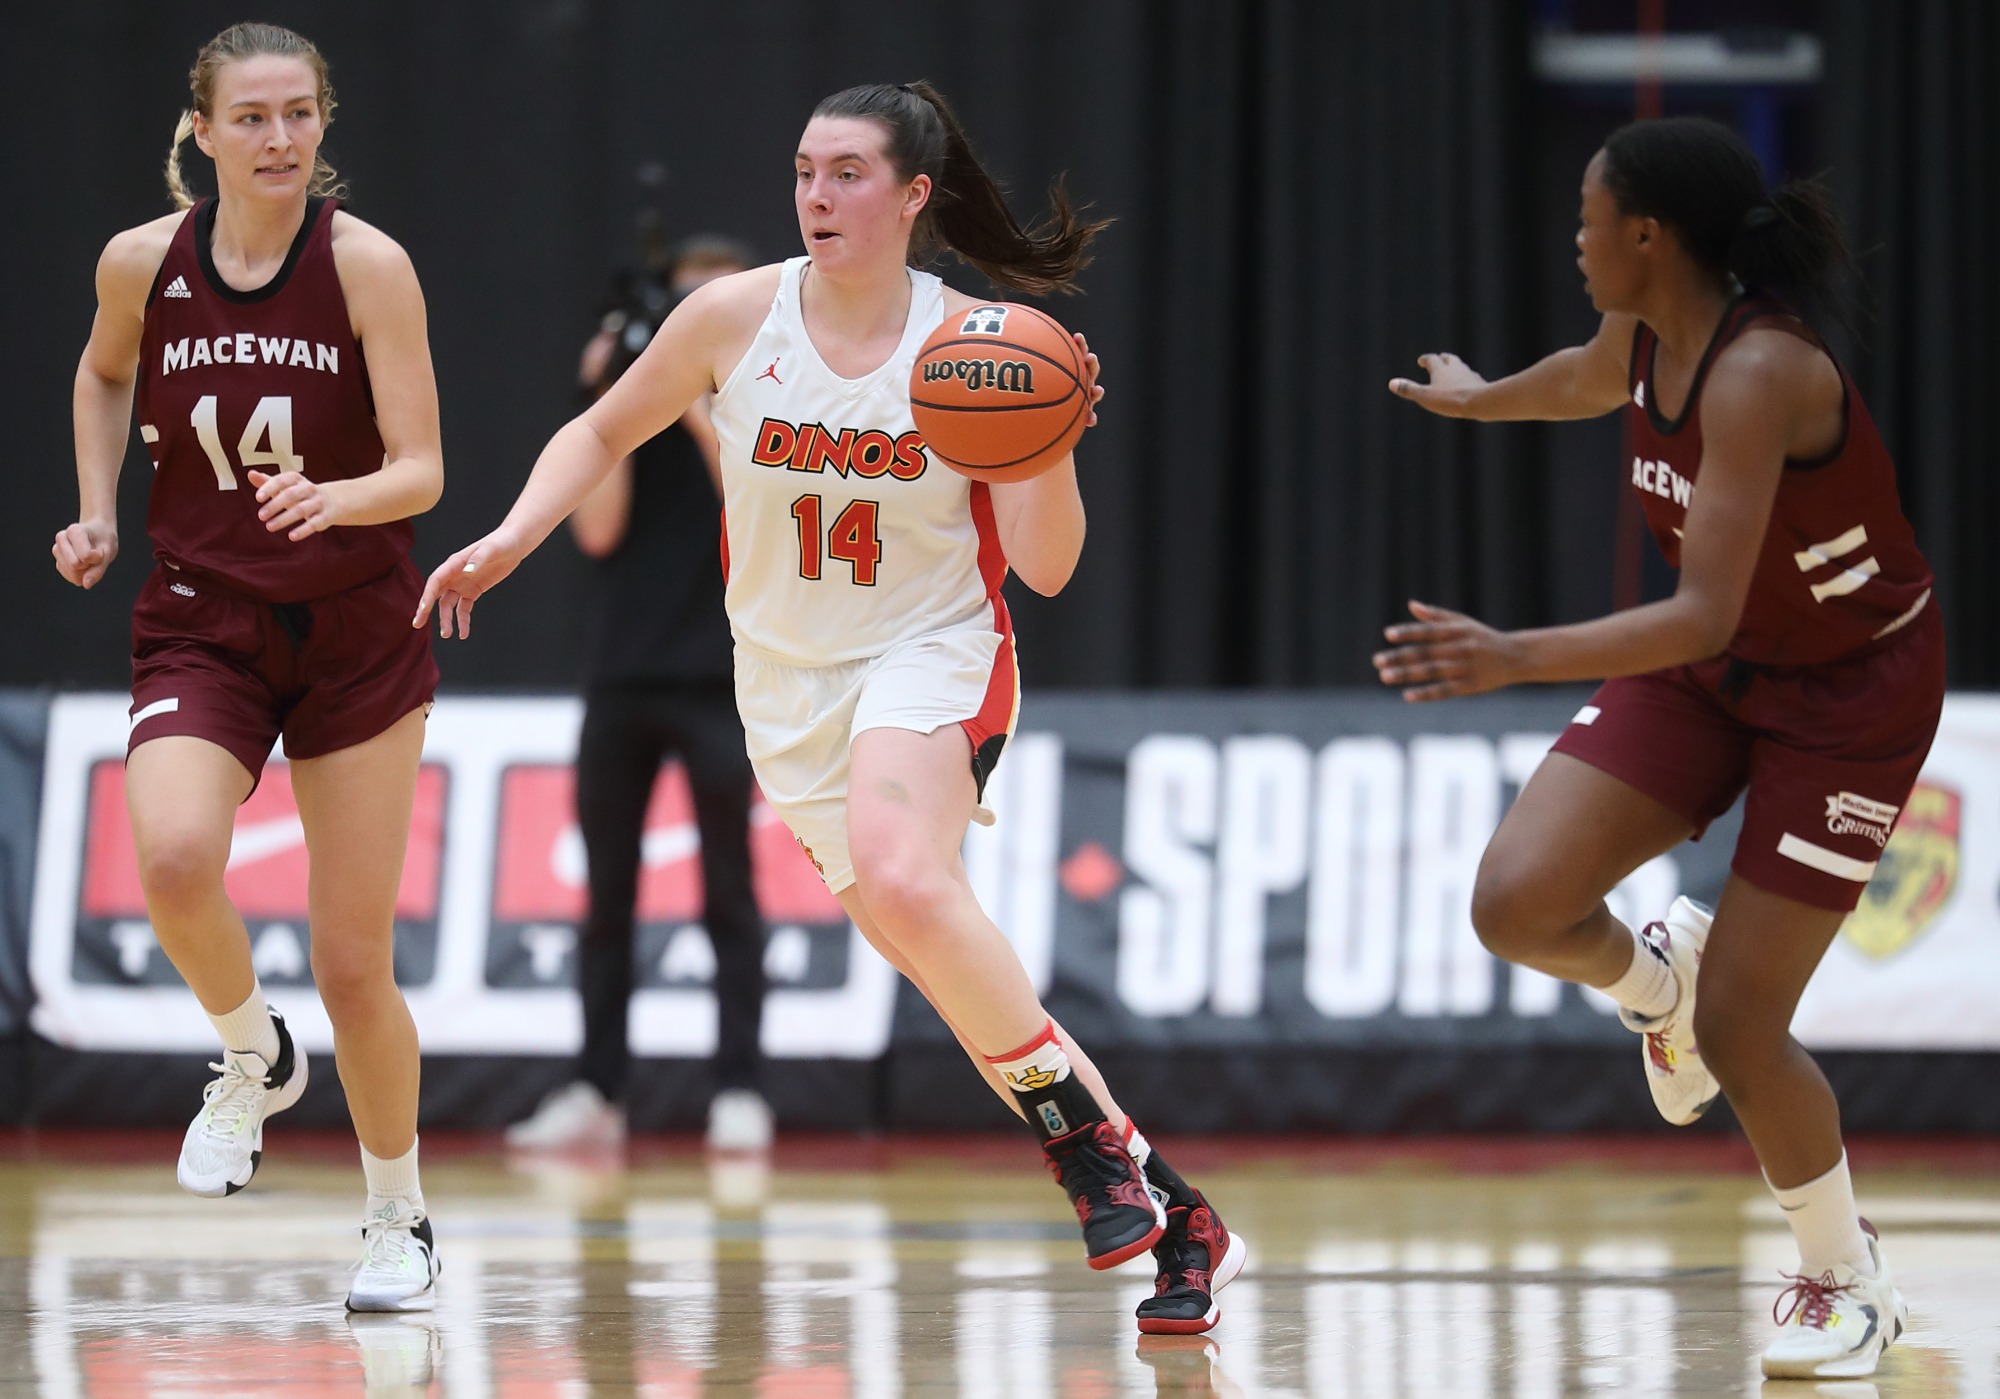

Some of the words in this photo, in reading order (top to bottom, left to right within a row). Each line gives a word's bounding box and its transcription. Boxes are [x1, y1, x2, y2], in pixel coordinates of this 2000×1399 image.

[164, 289, 192, 299] adidas
[922, 358, 1034, 395] Wilson
[190, 395, 304, 491] 14
[752, 417, 928, 480] DINOS
[1631, 456, 1696, 509] ACEW
[791, 493, 882, 586] 14
